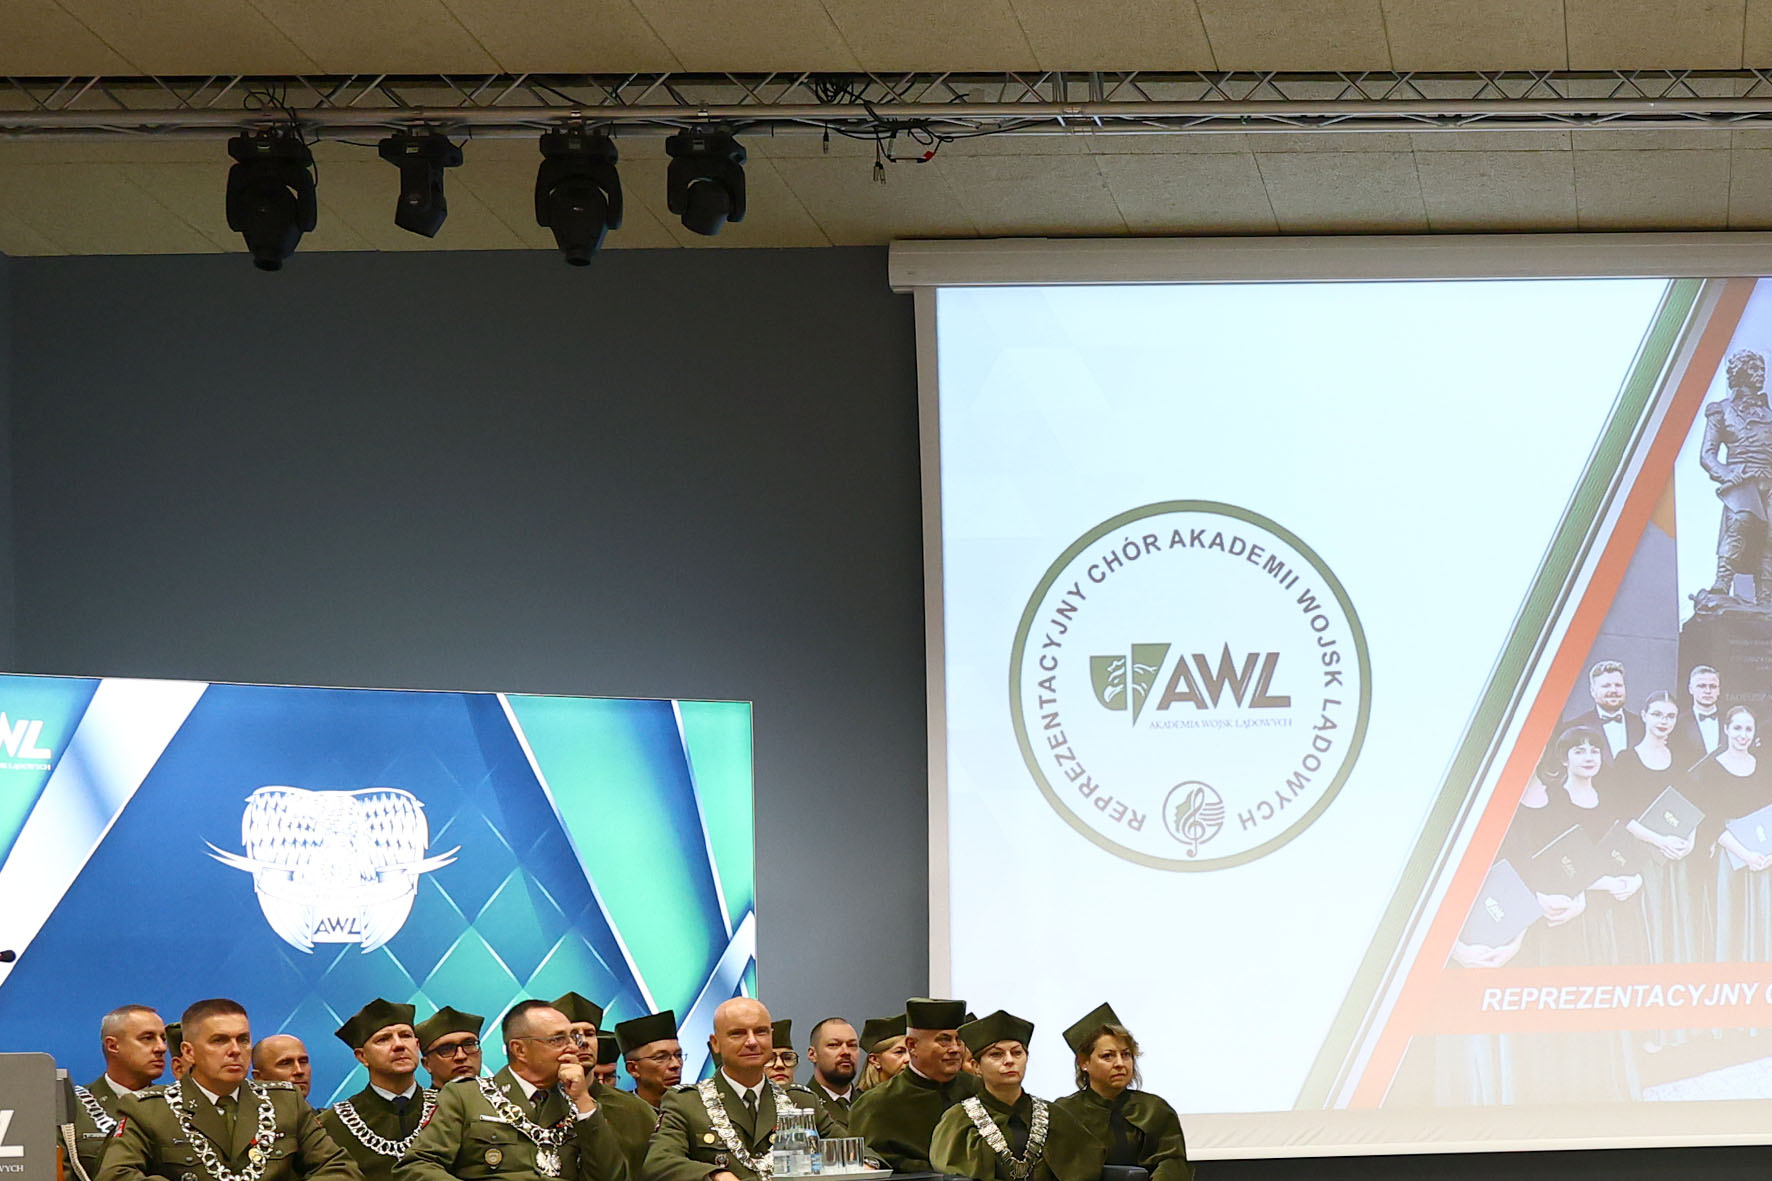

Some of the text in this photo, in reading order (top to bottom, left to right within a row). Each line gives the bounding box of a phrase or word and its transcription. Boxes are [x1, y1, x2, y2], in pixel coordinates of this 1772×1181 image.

[1038, 528, 1344, 832] REPREZENTACYJNY CHÓR AKADEMII WOJSK LĄDOWYCH
[1156, 641, 1291, 711] AWL
[0, 711, 52, 759] WL
[313, 916, 361, 935] AWL
[1481, 982, 1760, 1011] REPREZENTACYJNY
